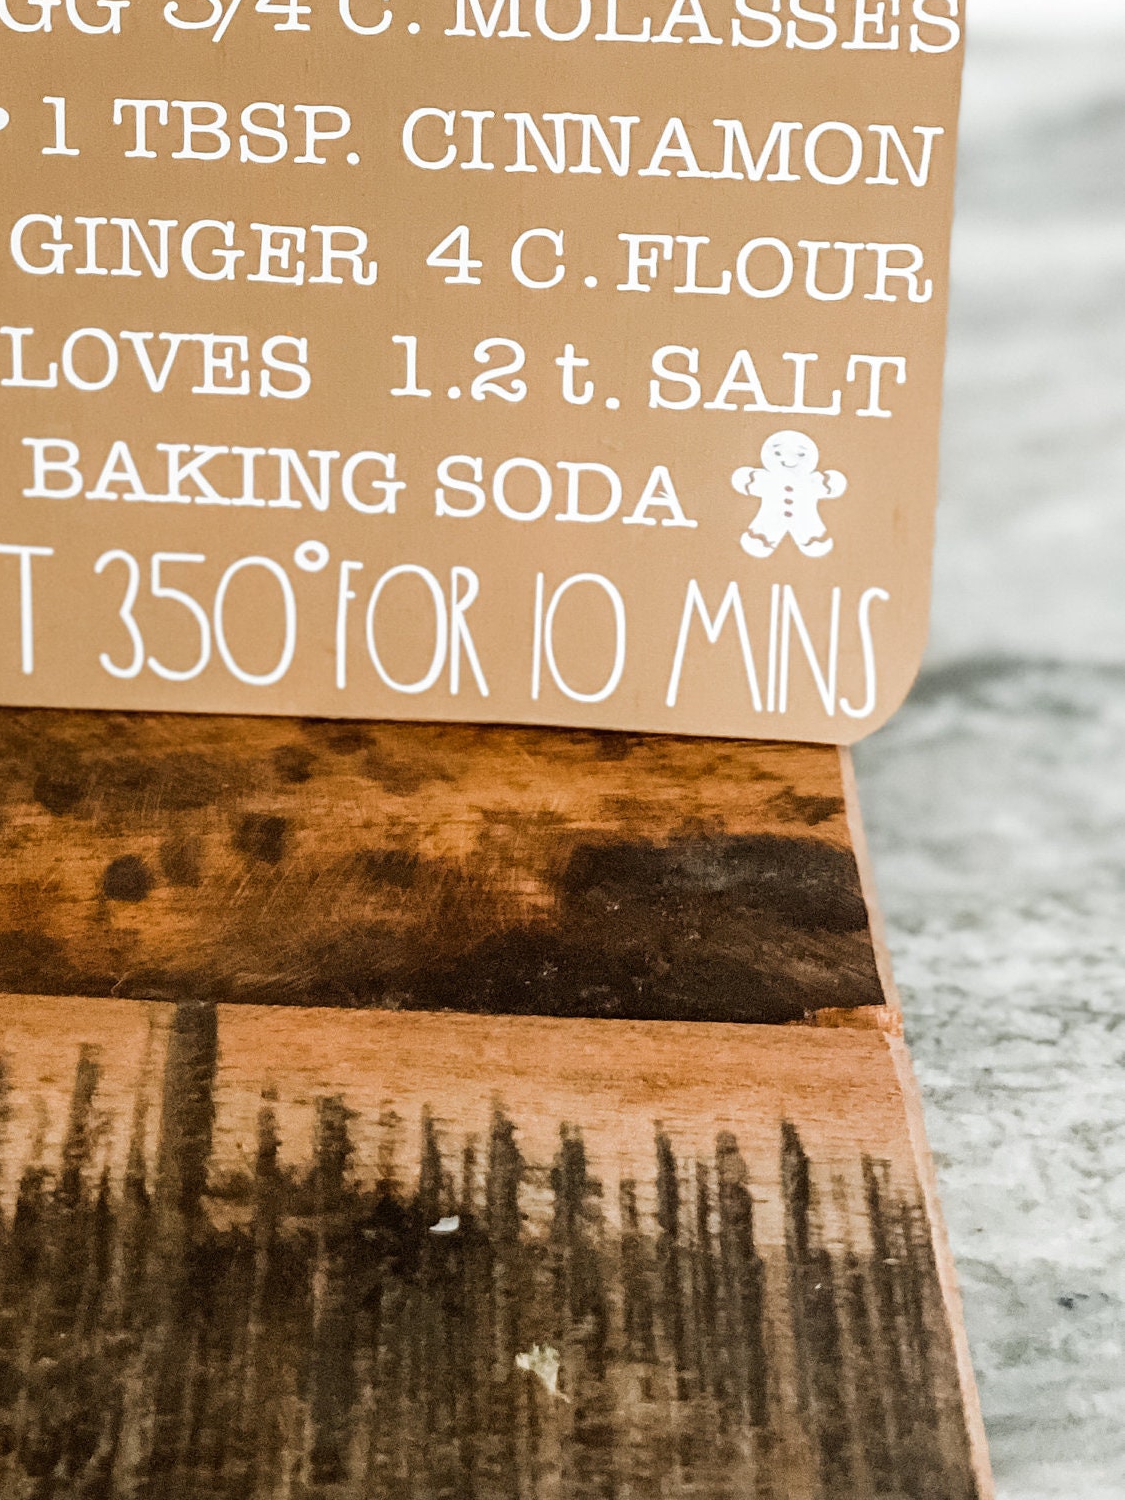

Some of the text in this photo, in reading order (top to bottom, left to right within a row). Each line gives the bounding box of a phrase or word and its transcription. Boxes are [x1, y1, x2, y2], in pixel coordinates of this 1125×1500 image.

[43, 98, 945, 188] 1 TBSP. CINNAMON
[12, 215, 378, 286] GINGER
[427, 227, 483, 285] 4
[392, 336, 528, 403] 1.2
[556, 345, 620, 411] t.
[650, 346, 907, 419] SALT
[23, 439, 407, 515] BAKING
[436, 456, 699, 529] SODA
[533, 574, 627, 704] 10
[667, 580, 891, 720] MINS
